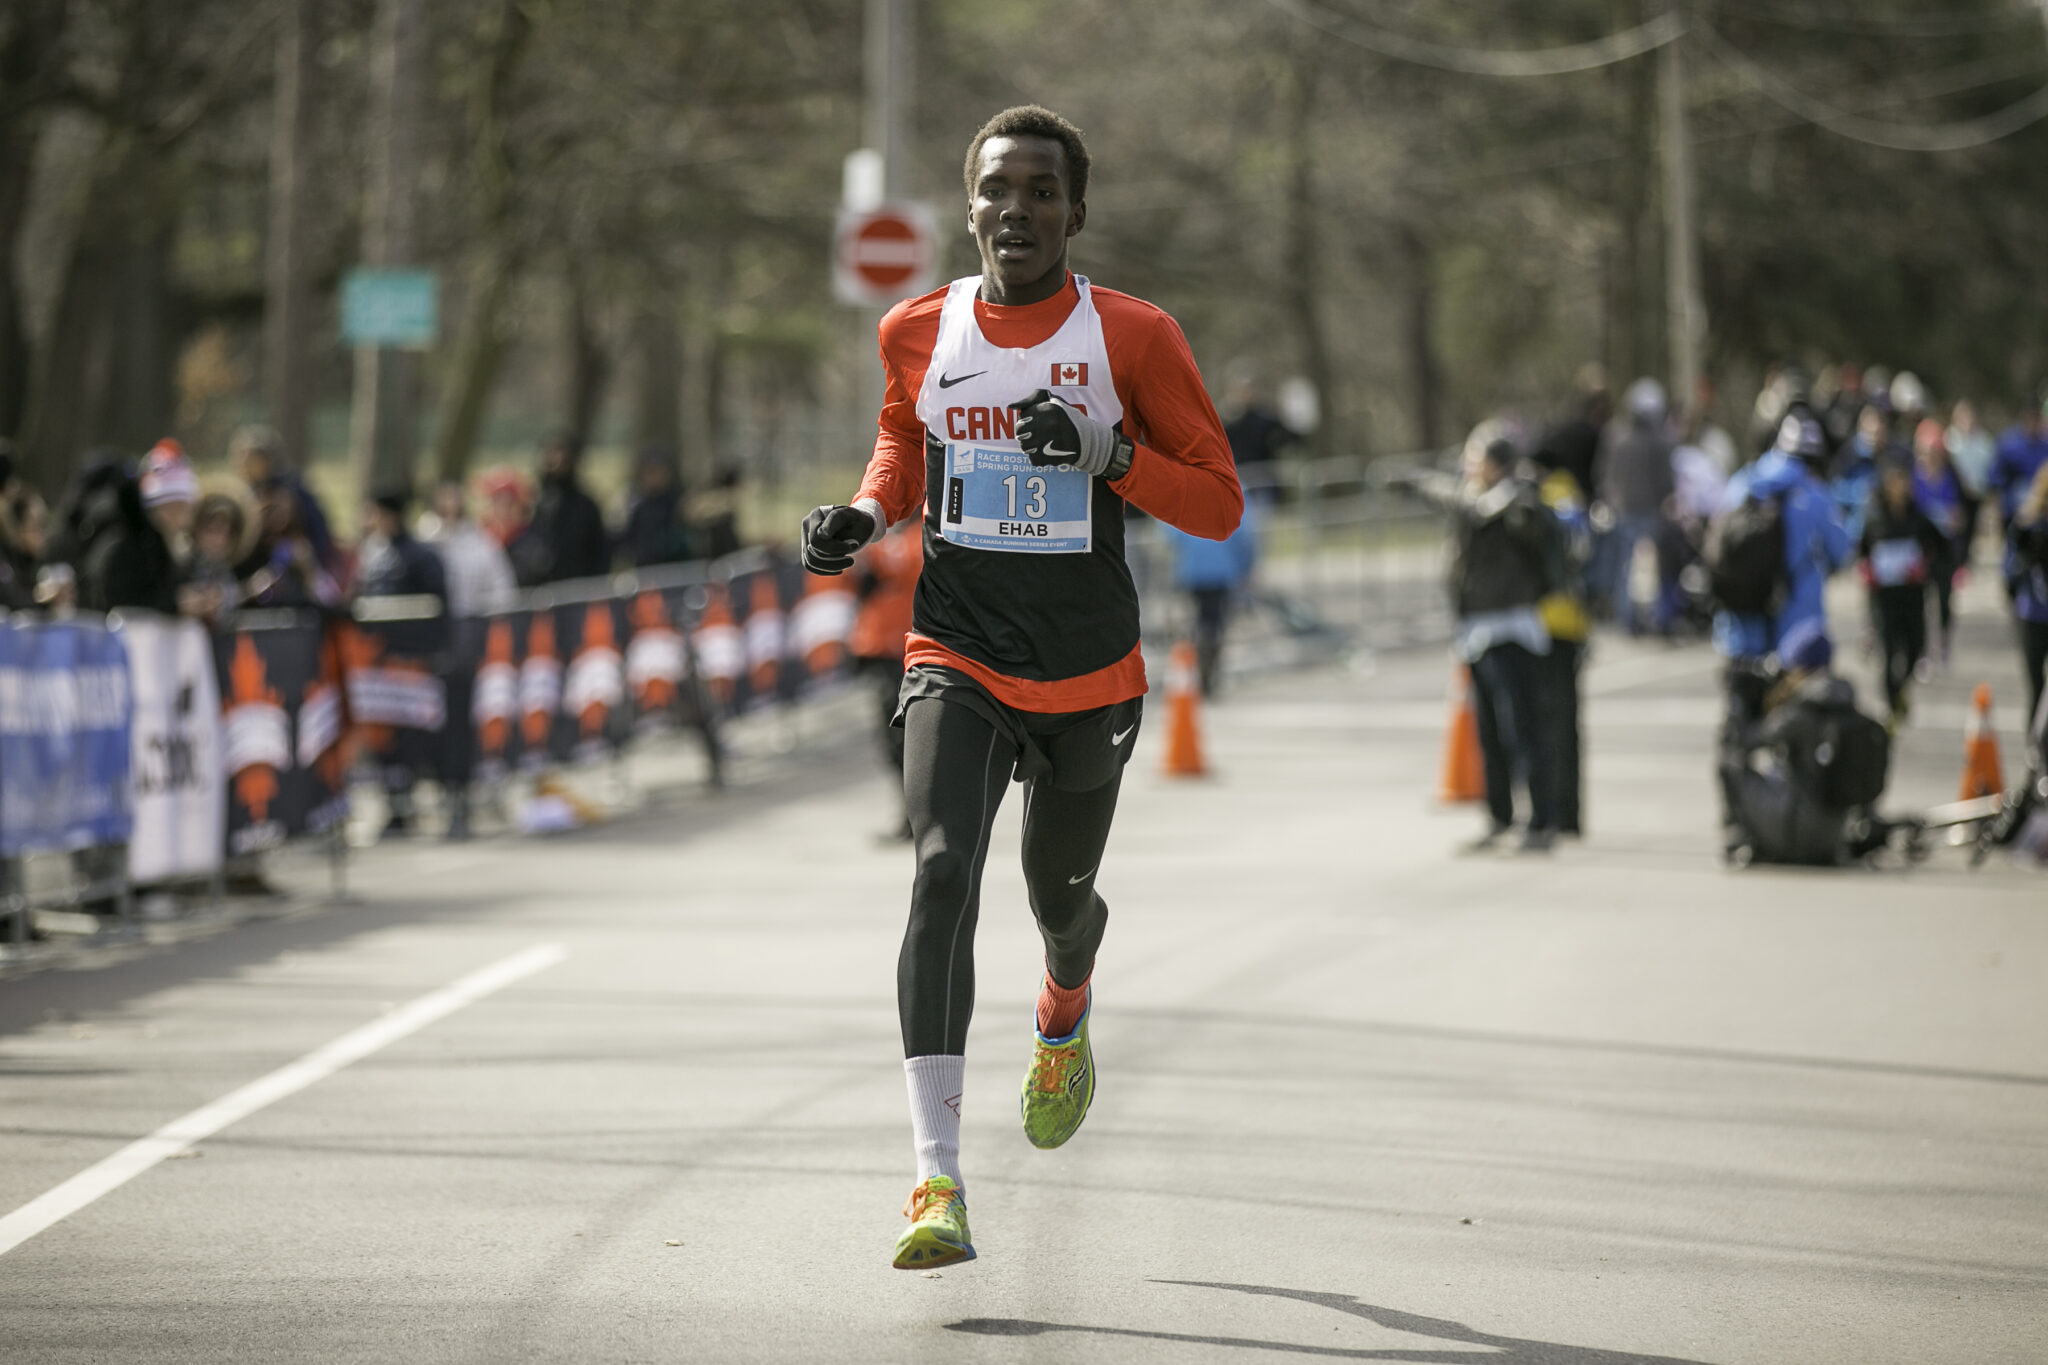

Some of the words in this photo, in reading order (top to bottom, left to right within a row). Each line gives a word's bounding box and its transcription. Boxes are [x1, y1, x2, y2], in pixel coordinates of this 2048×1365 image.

[946, 404, 1088, 440] CAN
[977, 452, 1000, 462] RACE
[1003, 455, 1032, 465] ROST
[977, 461, 1010, 472] SPRING
[1012, 463, 1055, 473] RUN-OFF
[1002, 474, 1048, 520] 13
[999, 521, 1049, 537] EHAB
